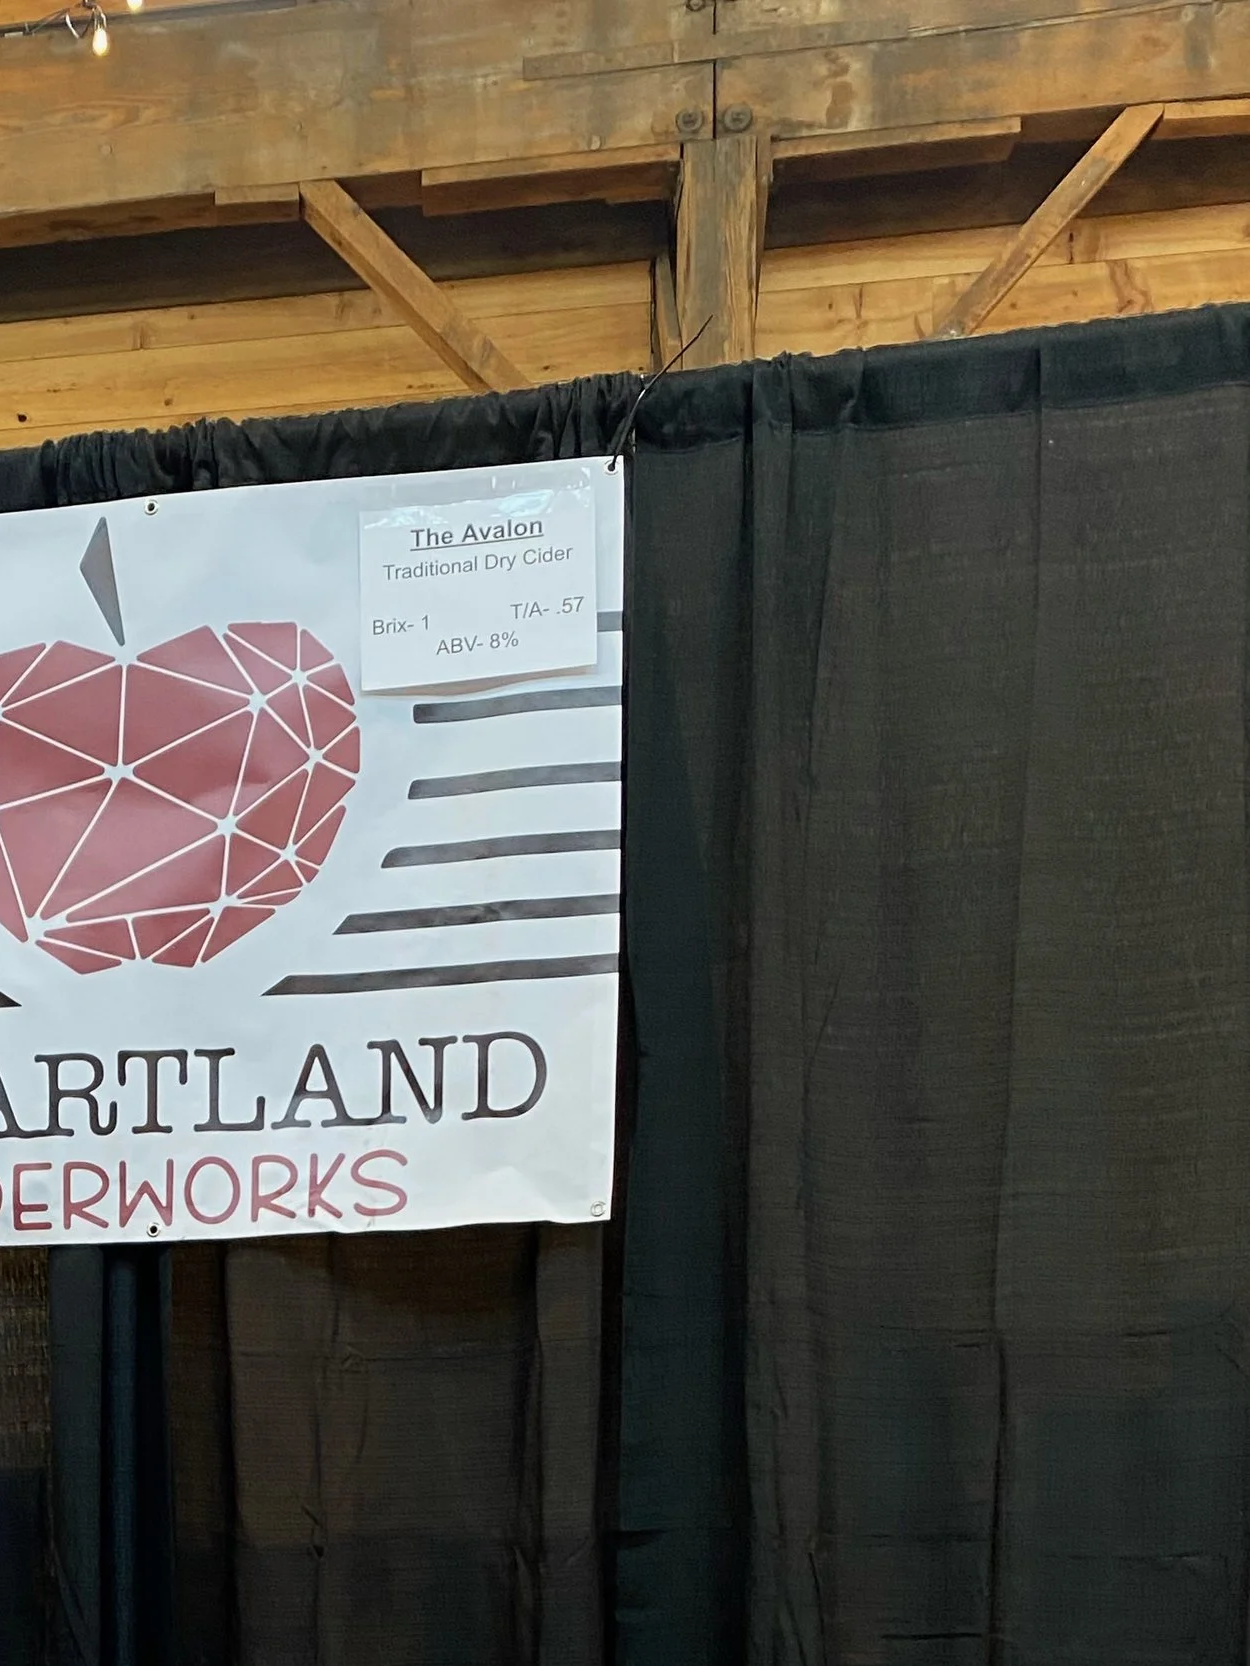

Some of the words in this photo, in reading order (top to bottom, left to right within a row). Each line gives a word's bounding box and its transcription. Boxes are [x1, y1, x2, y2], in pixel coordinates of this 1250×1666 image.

[411, 529, 453, 548] The
[462, 519, 543, 543] Avalon
[383, 556, 478, 580] Traditional
[485, 553, 517, 571] Dry
[523, 546, 573, 565] Cider
[510, 601, 550, 619] T/A-
[556, 596, 585, 615] .57
[372, 616, 414, 635] Brix-
[421, 614, 430, 630] 1
[436, 635, 484, 655] ABV-
[490, 631, 520, 649] 8%
